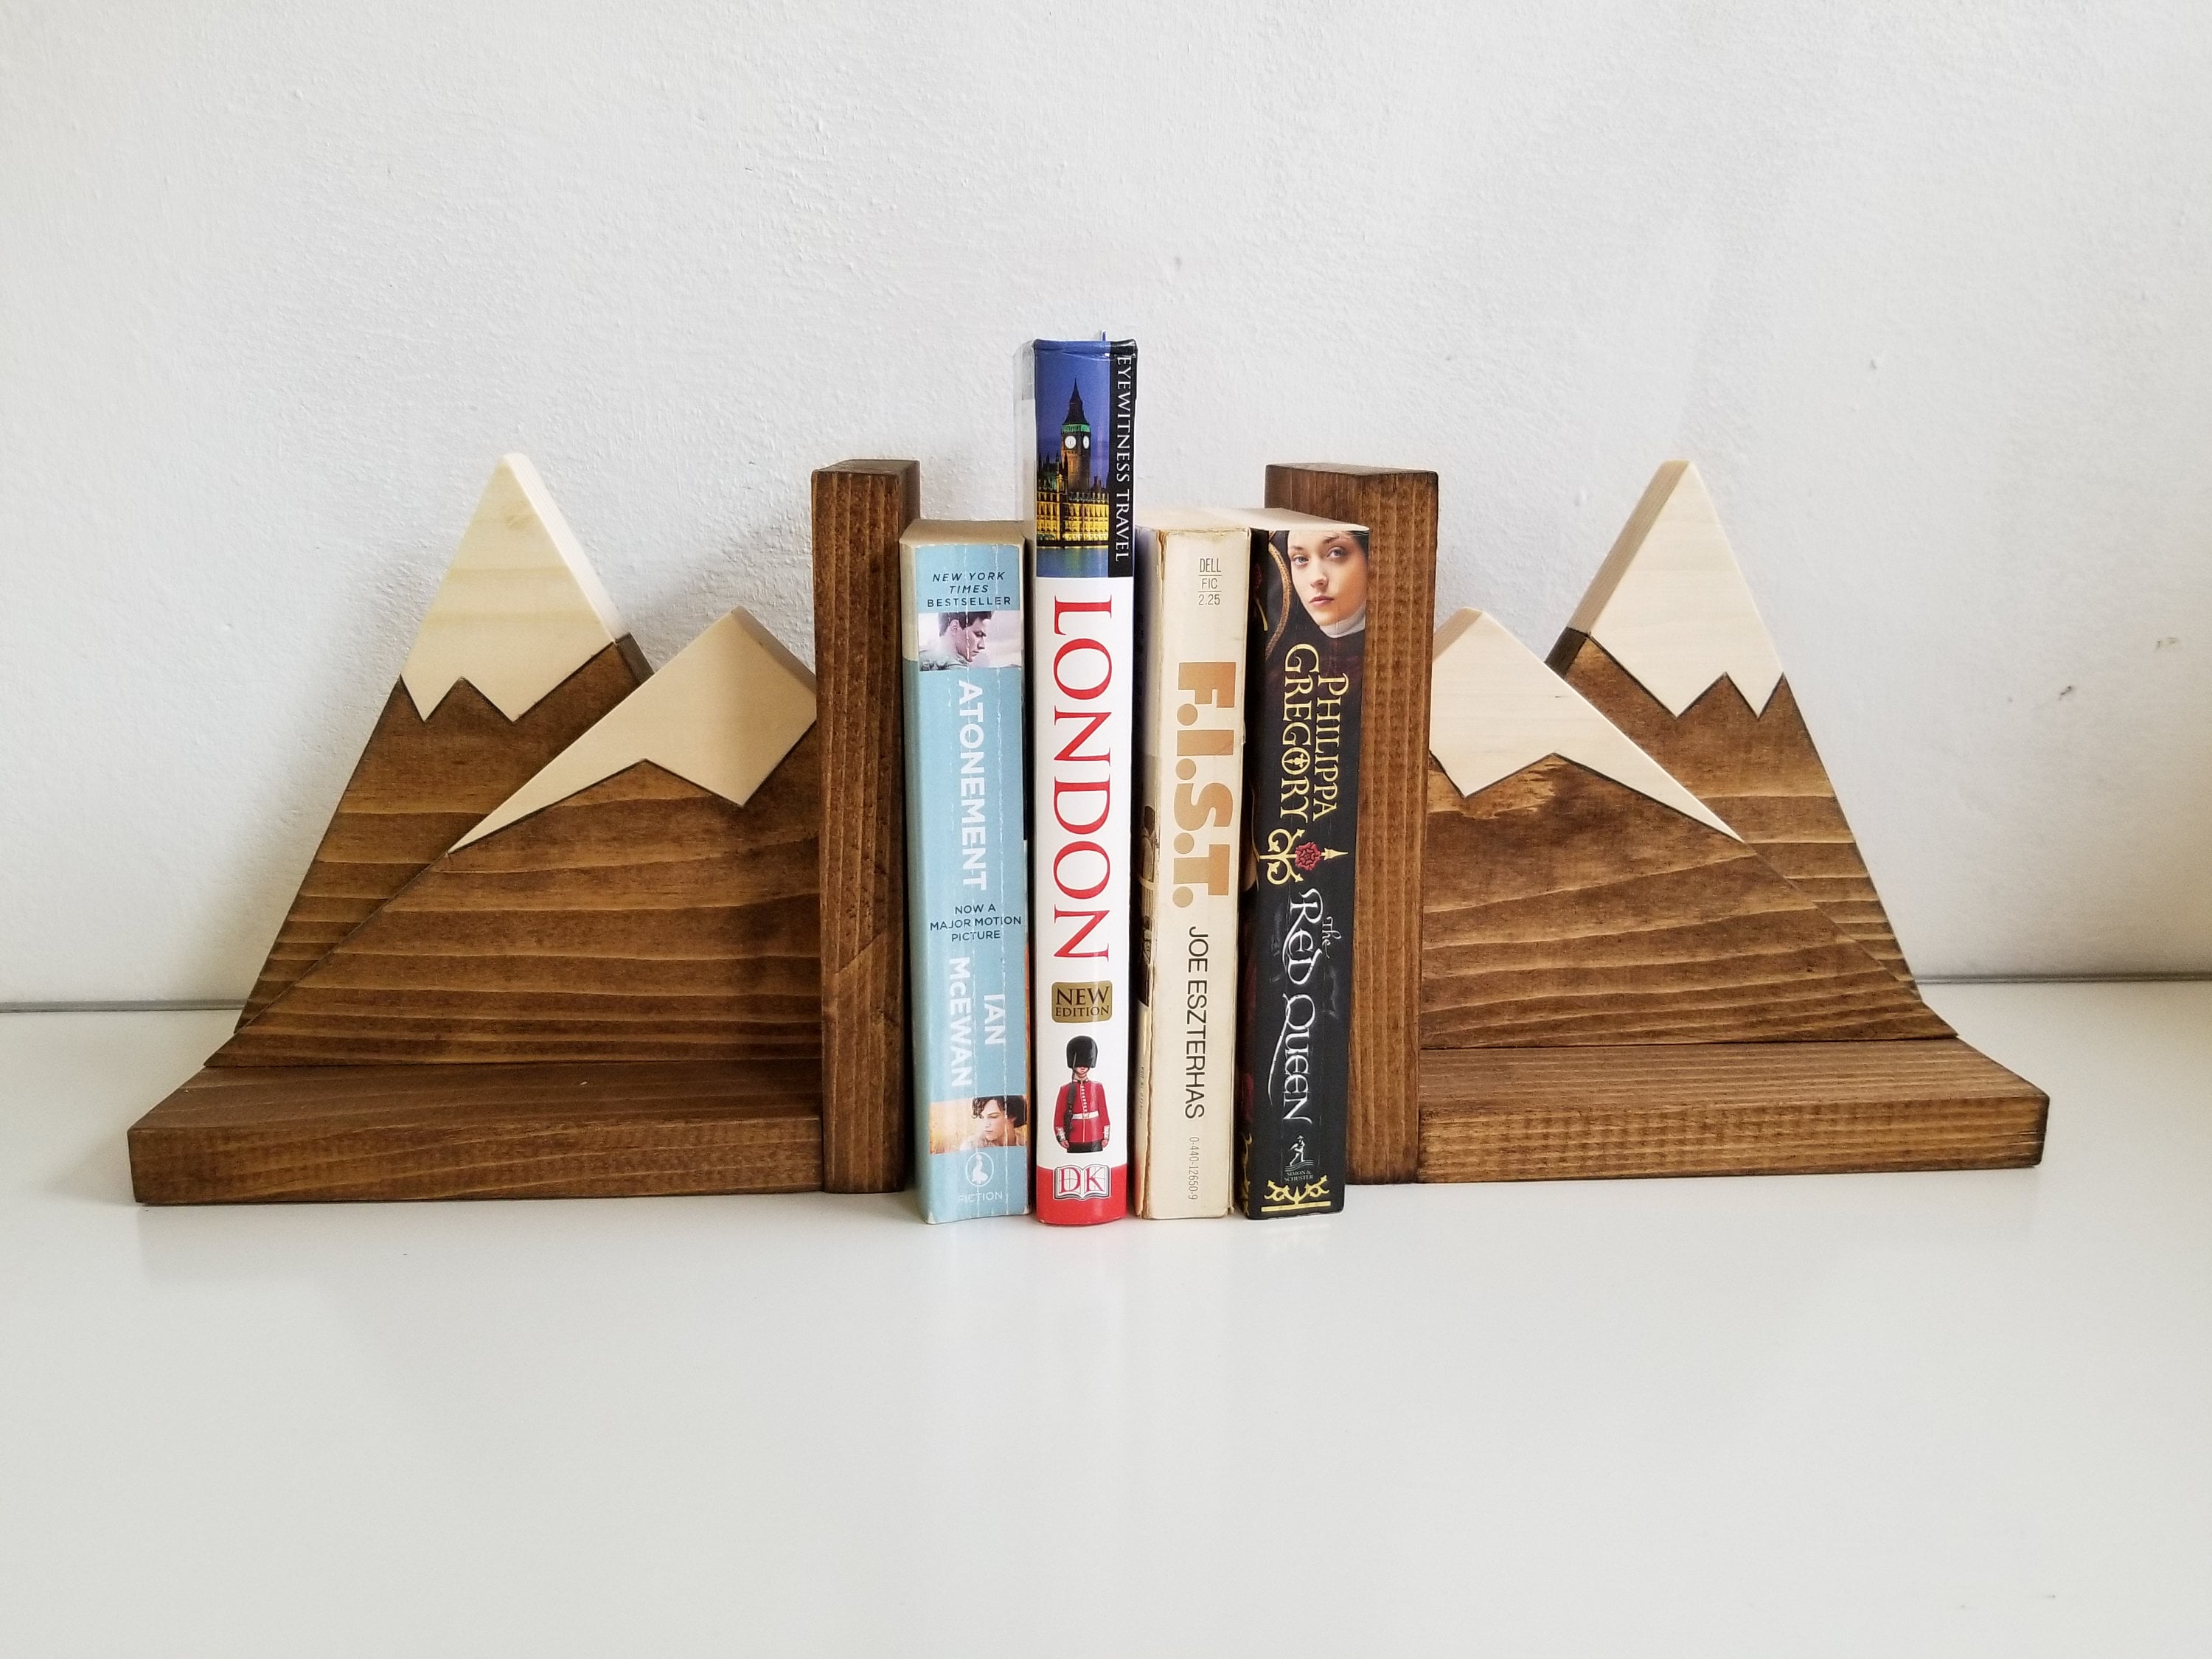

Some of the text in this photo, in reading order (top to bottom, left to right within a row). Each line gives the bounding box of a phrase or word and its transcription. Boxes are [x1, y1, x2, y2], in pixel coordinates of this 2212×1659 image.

[1115, 355, 1132, 562] EYEWITNESS TRAVEL
[1199, 557, 1222, 573] DELL
[932, 571, 1006, 582] NEW YORK
[1201, 577, 1218, 590] FIC
[949, 584, 990, 594] TIMES
[927, 596, 1011, 608] BESTSELLER
[1197, 594, 1221, 605] 2.25
[1280, 643, 1320, 824] GREGORY
[1312, 672, 1349, 823] PHILIPPA
[958, 679, 987, 891] ATONEMENT
[1053, 594, 1113, 962] LONDON
[1172, 661, 1236, 908] F.I.S.T.
[954, 903, 996, 915] NOW A
[929, 916, 1022, 931] MAJOR MOTION
[951, 930, 1001, 942] PICTURE
[1321, 916, 1342, 959] The
[1055, 986, 1110, 1006] NEW
[984, 994, 1006, 1046] IAN
[1054, 1005, 1110, 1018] EDITION
[1184, 925, 1209, 1119] JOE ESZTERHAS
[1188, 1136, 1200, 1201] 0-440-12650-9
[1059, 1168, 1105, 1194] DK
[959, 1191, 1003, 1203] FICTION
